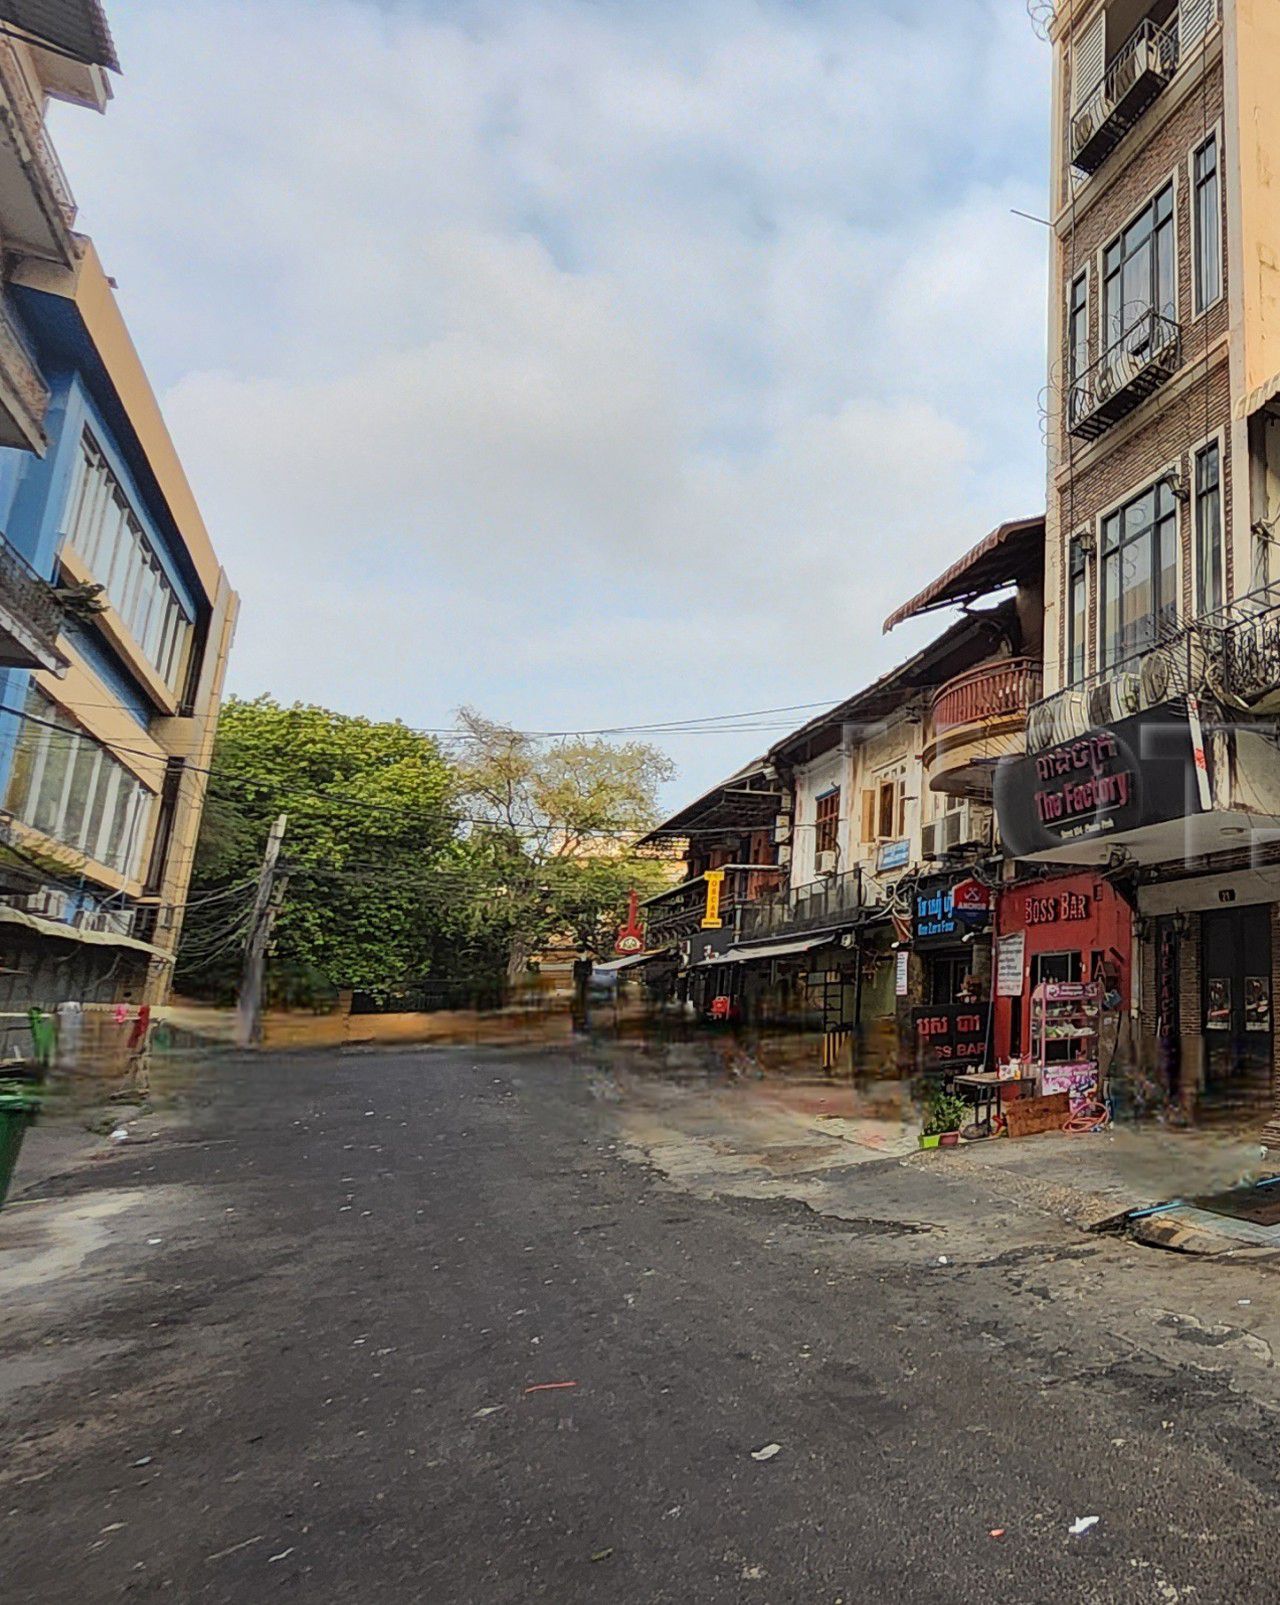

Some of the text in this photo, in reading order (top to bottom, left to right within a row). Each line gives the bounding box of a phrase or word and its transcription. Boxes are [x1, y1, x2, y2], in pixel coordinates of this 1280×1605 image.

[1034, 771, 1130, 822] The Factory
[1025, 892, 1087, 924] BOSS BAR
